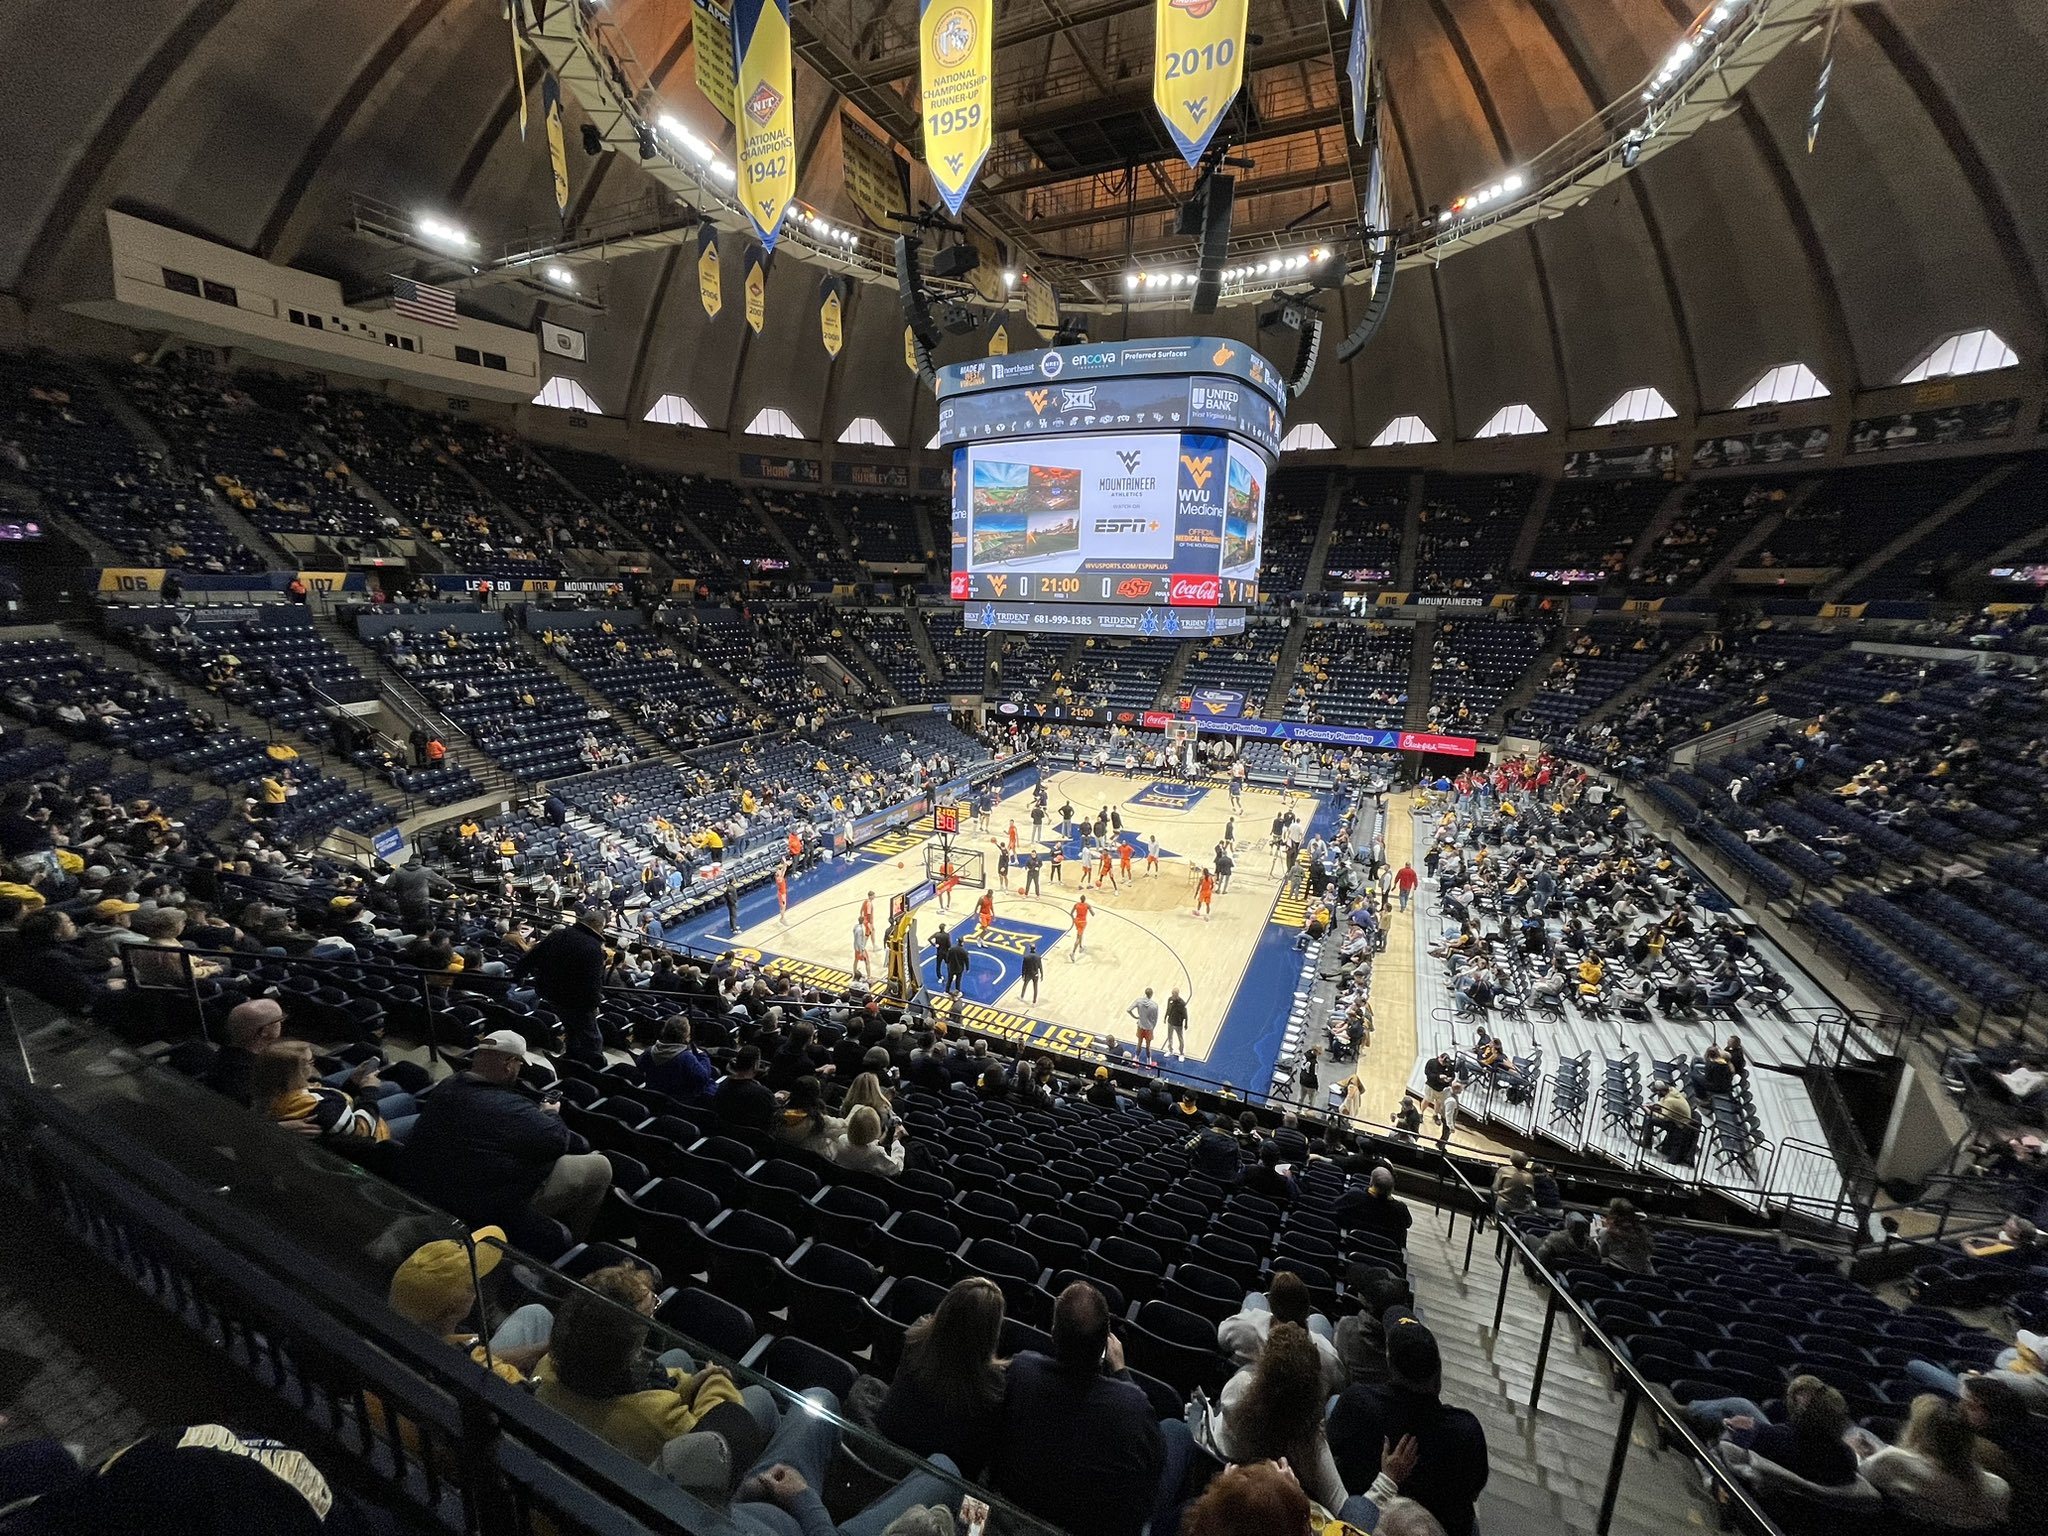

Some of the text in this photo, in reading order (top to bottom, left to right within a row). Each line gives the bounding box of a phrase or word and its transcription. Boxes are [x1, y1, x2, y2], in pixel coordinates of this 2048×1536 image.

[1165, 38, 1234, 81] 2010
[933, 68, 976, 87] NATIONAL
[923, 74, 988, 99] CHAMPIONSHIP
[752, 97, 774, 113] NIT
[931, 89, 979, 109] RUNNER-UP
[928, 103, 981, 137] 1959
[744, 128, 787, 147] NATIONAL
[740, 136, 793, 162] CHAMPIONS
[747, 155, 787, 184] 1942
[1072, 352, 1116, 366] encova
[1124, 350, 1188, 361] Preferred Surfaces
[1003, 363, 1035, 376] northeast
[1206, 388, 1239, 403] UNITED
[1206, 399, 1232, 412] BANK
[1099, 477, 1156, 491] MOUNTAINEER
[1179, 489, 1211, 503] WVU
[1179, 502, 1223, 518] Medicine
[1085, 562, 1169, 570] WVUSPORTS.COM/ESPNPLUS
[465, 580, 511, 591] LES GO
[564, 581, 624, 591] MOUNTAINES
[1019, 576, 1029, 596] 0
[1041, 577, 1080, 593] 21:00
[1102, 577, 1112, 598] 0
[1418, 596, 1483, 607] MOUNTAINEERS
[996, 612, 1030, 621] TRIDENT
[1034, 614, 1092, 626] 681-999-1385
[1097, 615, 1139, 625] TRIDENT
[1180, 619, 1207, 627] TRIDENT
[1071, 707, 1095, 718] 21:00
[1232, 722, 1267, 734] Plumbing
[1294, 727, 1374, 744] Tri-County Plumbing
